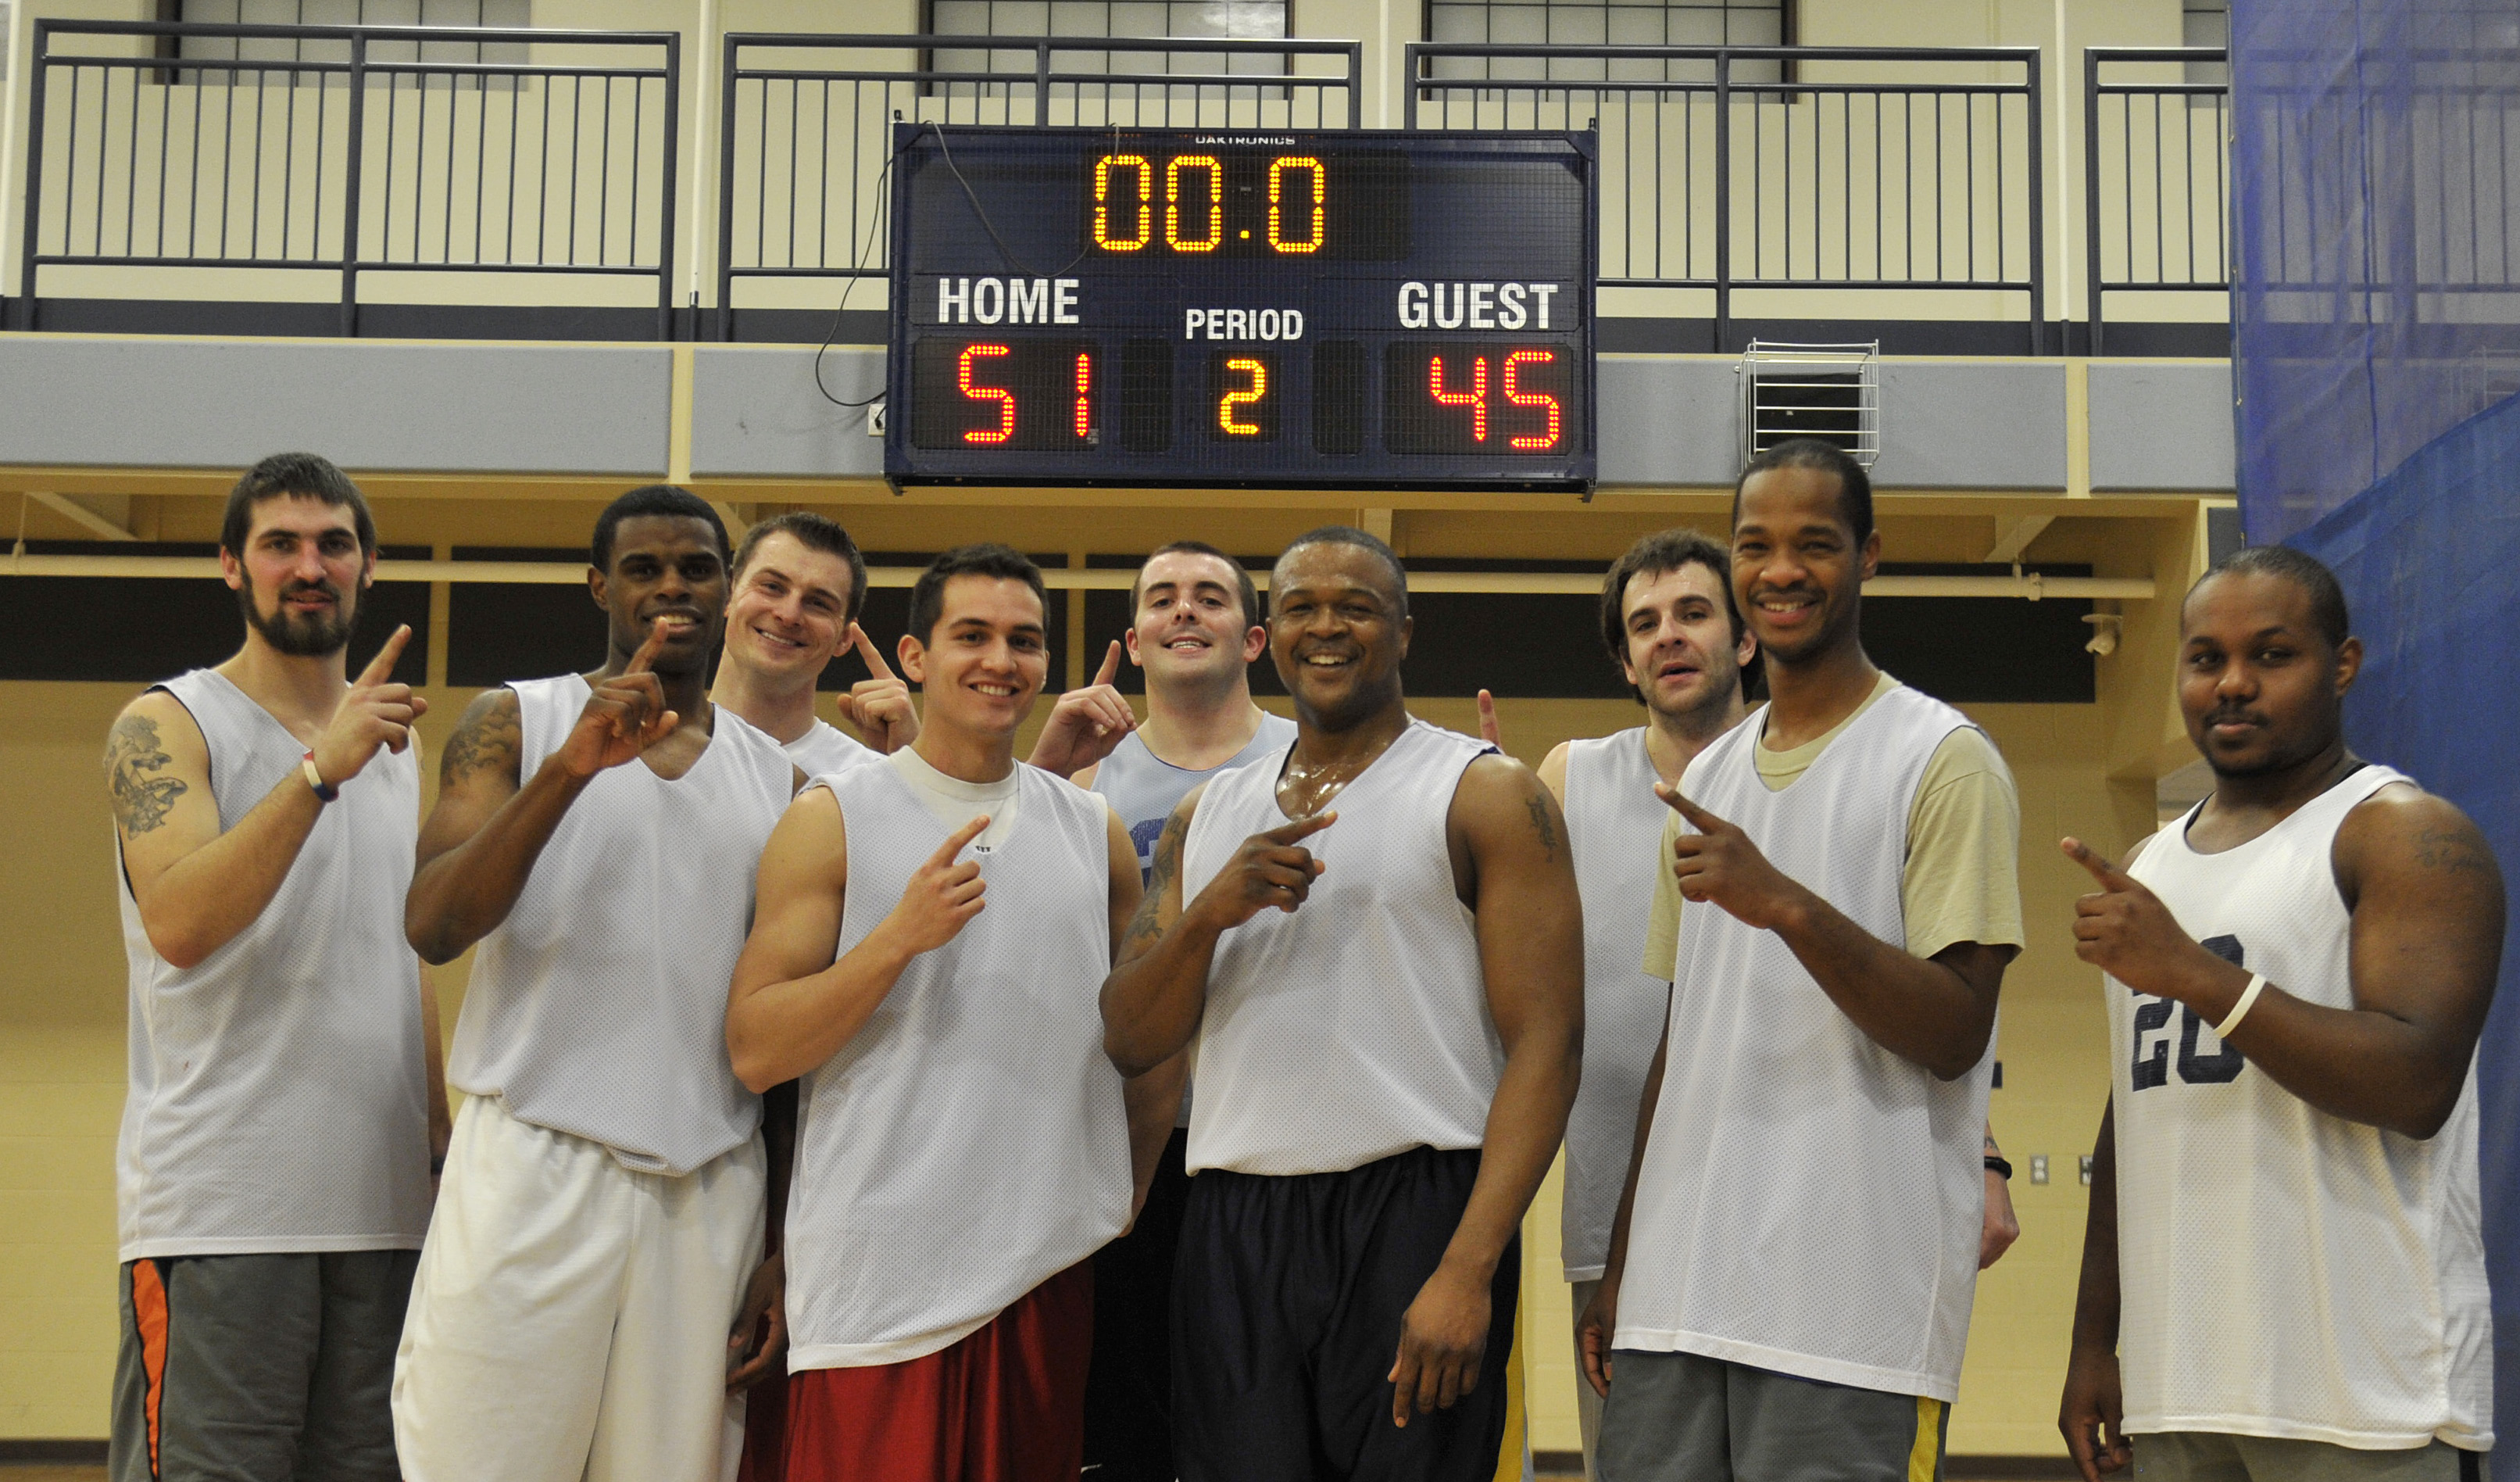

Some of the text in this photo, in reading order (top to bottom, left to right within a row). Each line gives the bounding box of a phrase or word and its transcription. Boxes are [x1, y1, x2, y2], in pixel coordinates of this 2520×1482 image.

[939, 278, 1079, 324] HOME
[1186, 310, 1303, 341] PERIOD
[1399, 282, 1559, 330] GUEST
[958, 345, 1091, 444] 51
[1220, 359, 1266, 435] 2
[1429, 351, 1560, 449] 45
